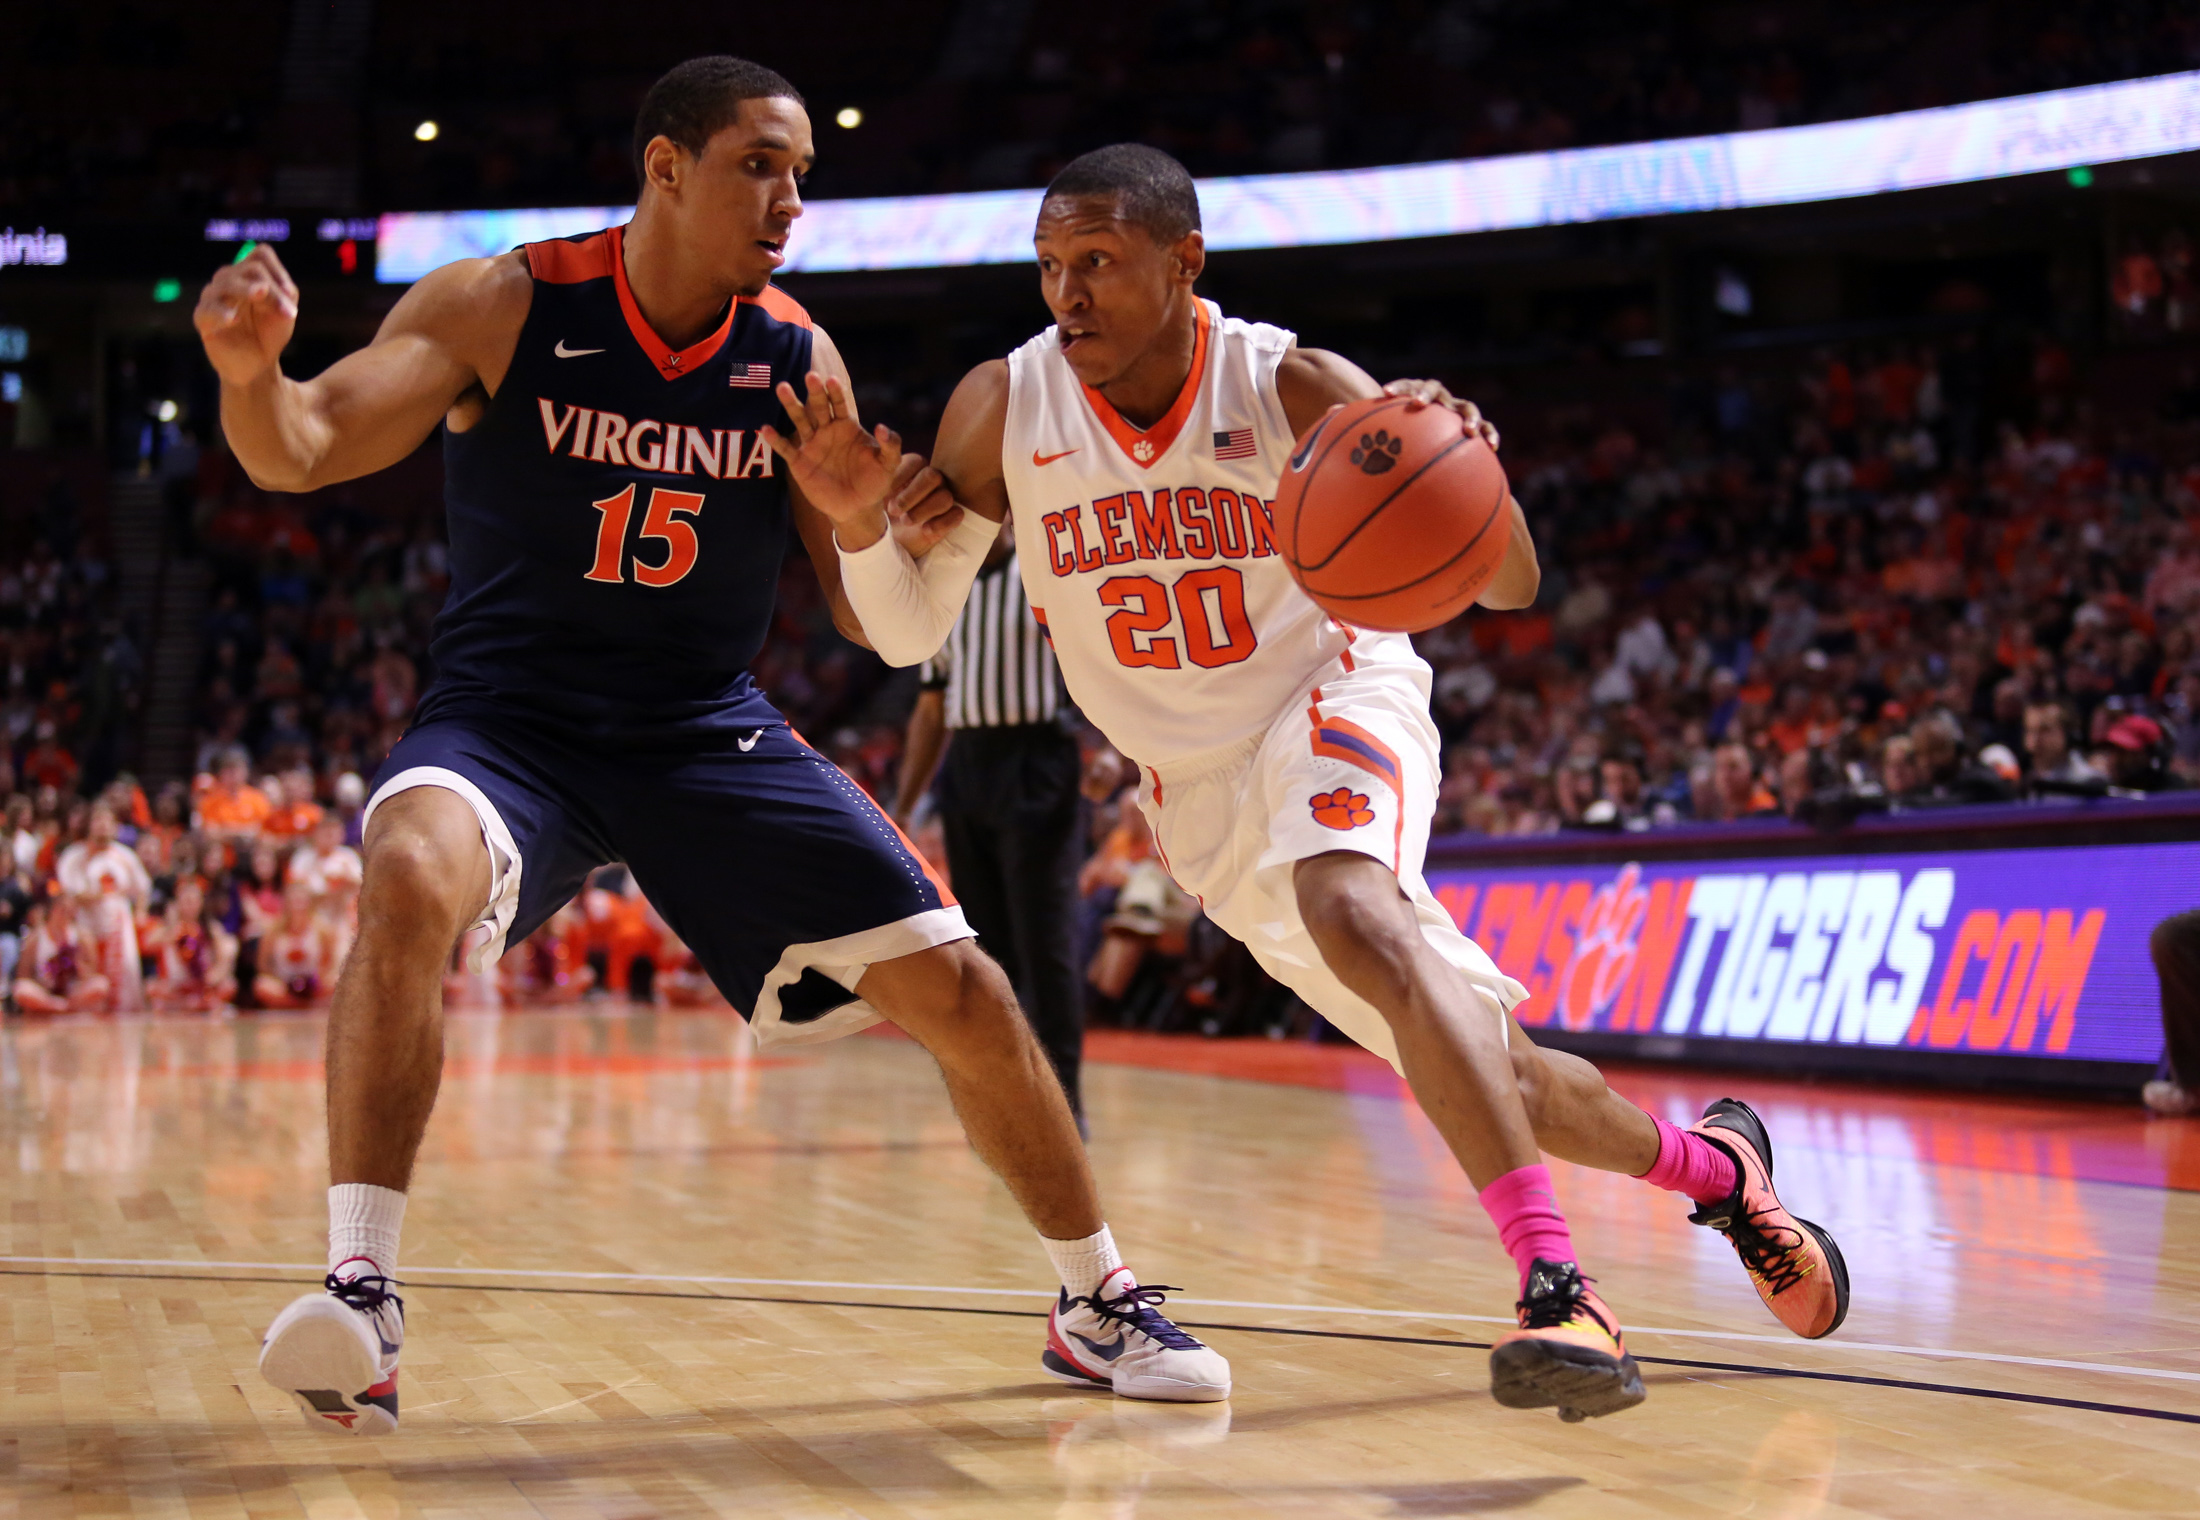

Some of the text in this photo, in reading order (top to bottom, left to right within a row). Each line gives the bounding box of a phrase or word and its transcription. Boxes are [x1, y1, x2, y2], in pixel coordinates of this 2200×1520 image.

[0, 226, 68, 266] inia
[537, 397, 774, 480] VIRGINIA
[583, 482, 706, 588] 15
[1041, 486, 1281, 577] CLEMSON
[1097, 564, 1258, 669] 20
